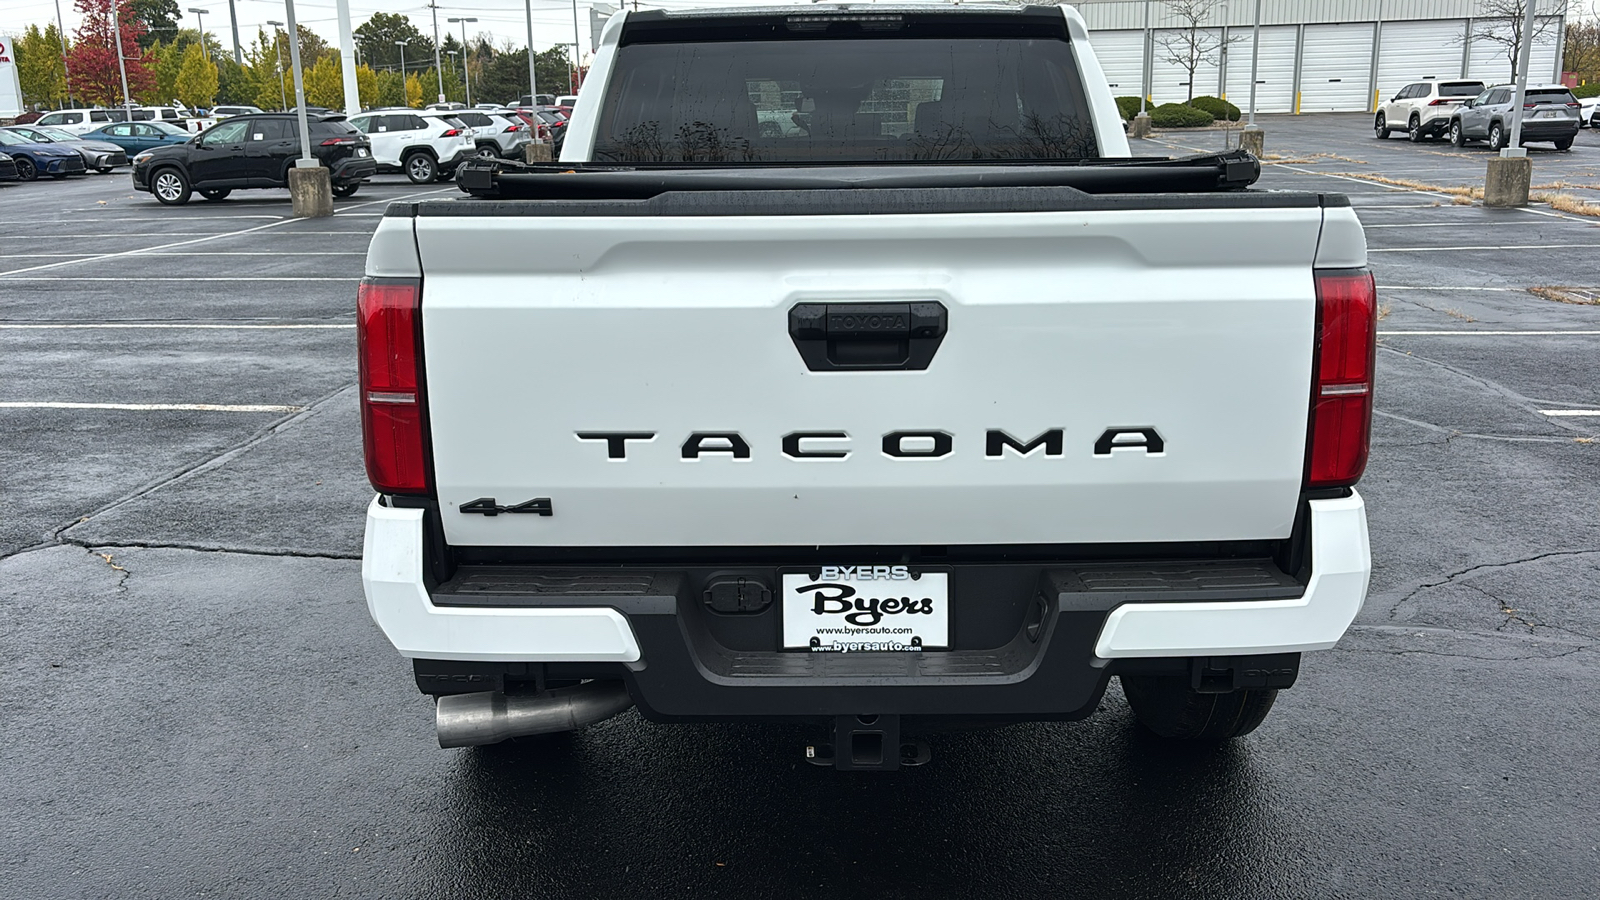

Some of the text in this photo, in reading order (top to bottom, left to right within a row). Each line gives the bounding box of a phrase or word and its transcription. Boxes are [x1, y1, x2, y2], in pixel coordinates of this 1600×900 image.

[831, 315, 906, 329] TOYOTA
[574, 426, 1166, 461] TACOMA
[821, 565, 909, 581] BYERS
[795, 583, 933, 626] Byers
[816, 626, 913, 636] www.byersauto.com
[811, 640, 922, 653] www.byersauto.com
